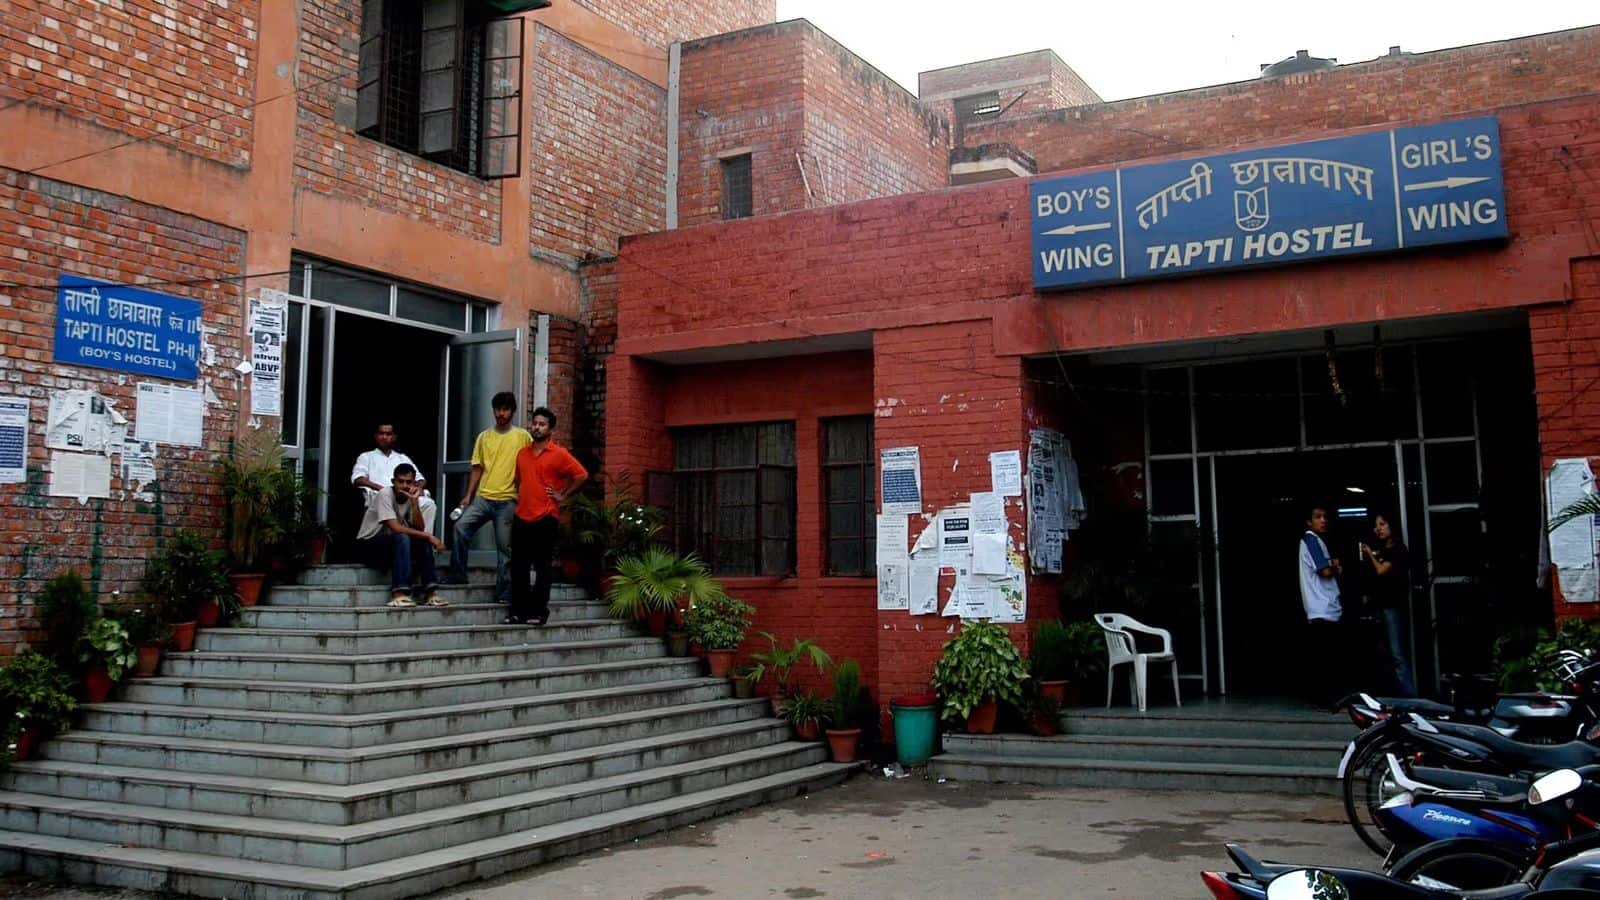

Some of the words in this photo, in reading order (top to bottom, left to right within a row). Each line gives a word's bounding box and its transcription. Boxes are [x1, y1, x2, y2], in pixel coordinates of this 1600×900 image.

[1401, 133, 1493, 169] GIRL'S
[1037, 186, 1111, 217] BOY'S
[1136, 162, 1213, 230] ताप्ती
[1407, 198, 1498, 231] WING
[1040, 243, 1114, 273] WING
[1146, 237, 1234, 269] TAPTI
[1243, 222, 1373, 260] HOSTEL
[64, 287, 101, 316] ताप्ती
[107, 298, 163, 327] छात्रावास
[63, 318, 103, 343] TAPTI
[105, 326, 161, 353] HOSTEL
[80, 346, 121, 361] (BOY'S
[124, 353, 176, 370] HOSTEL)
[254, 362, 280, 373] ABVP
